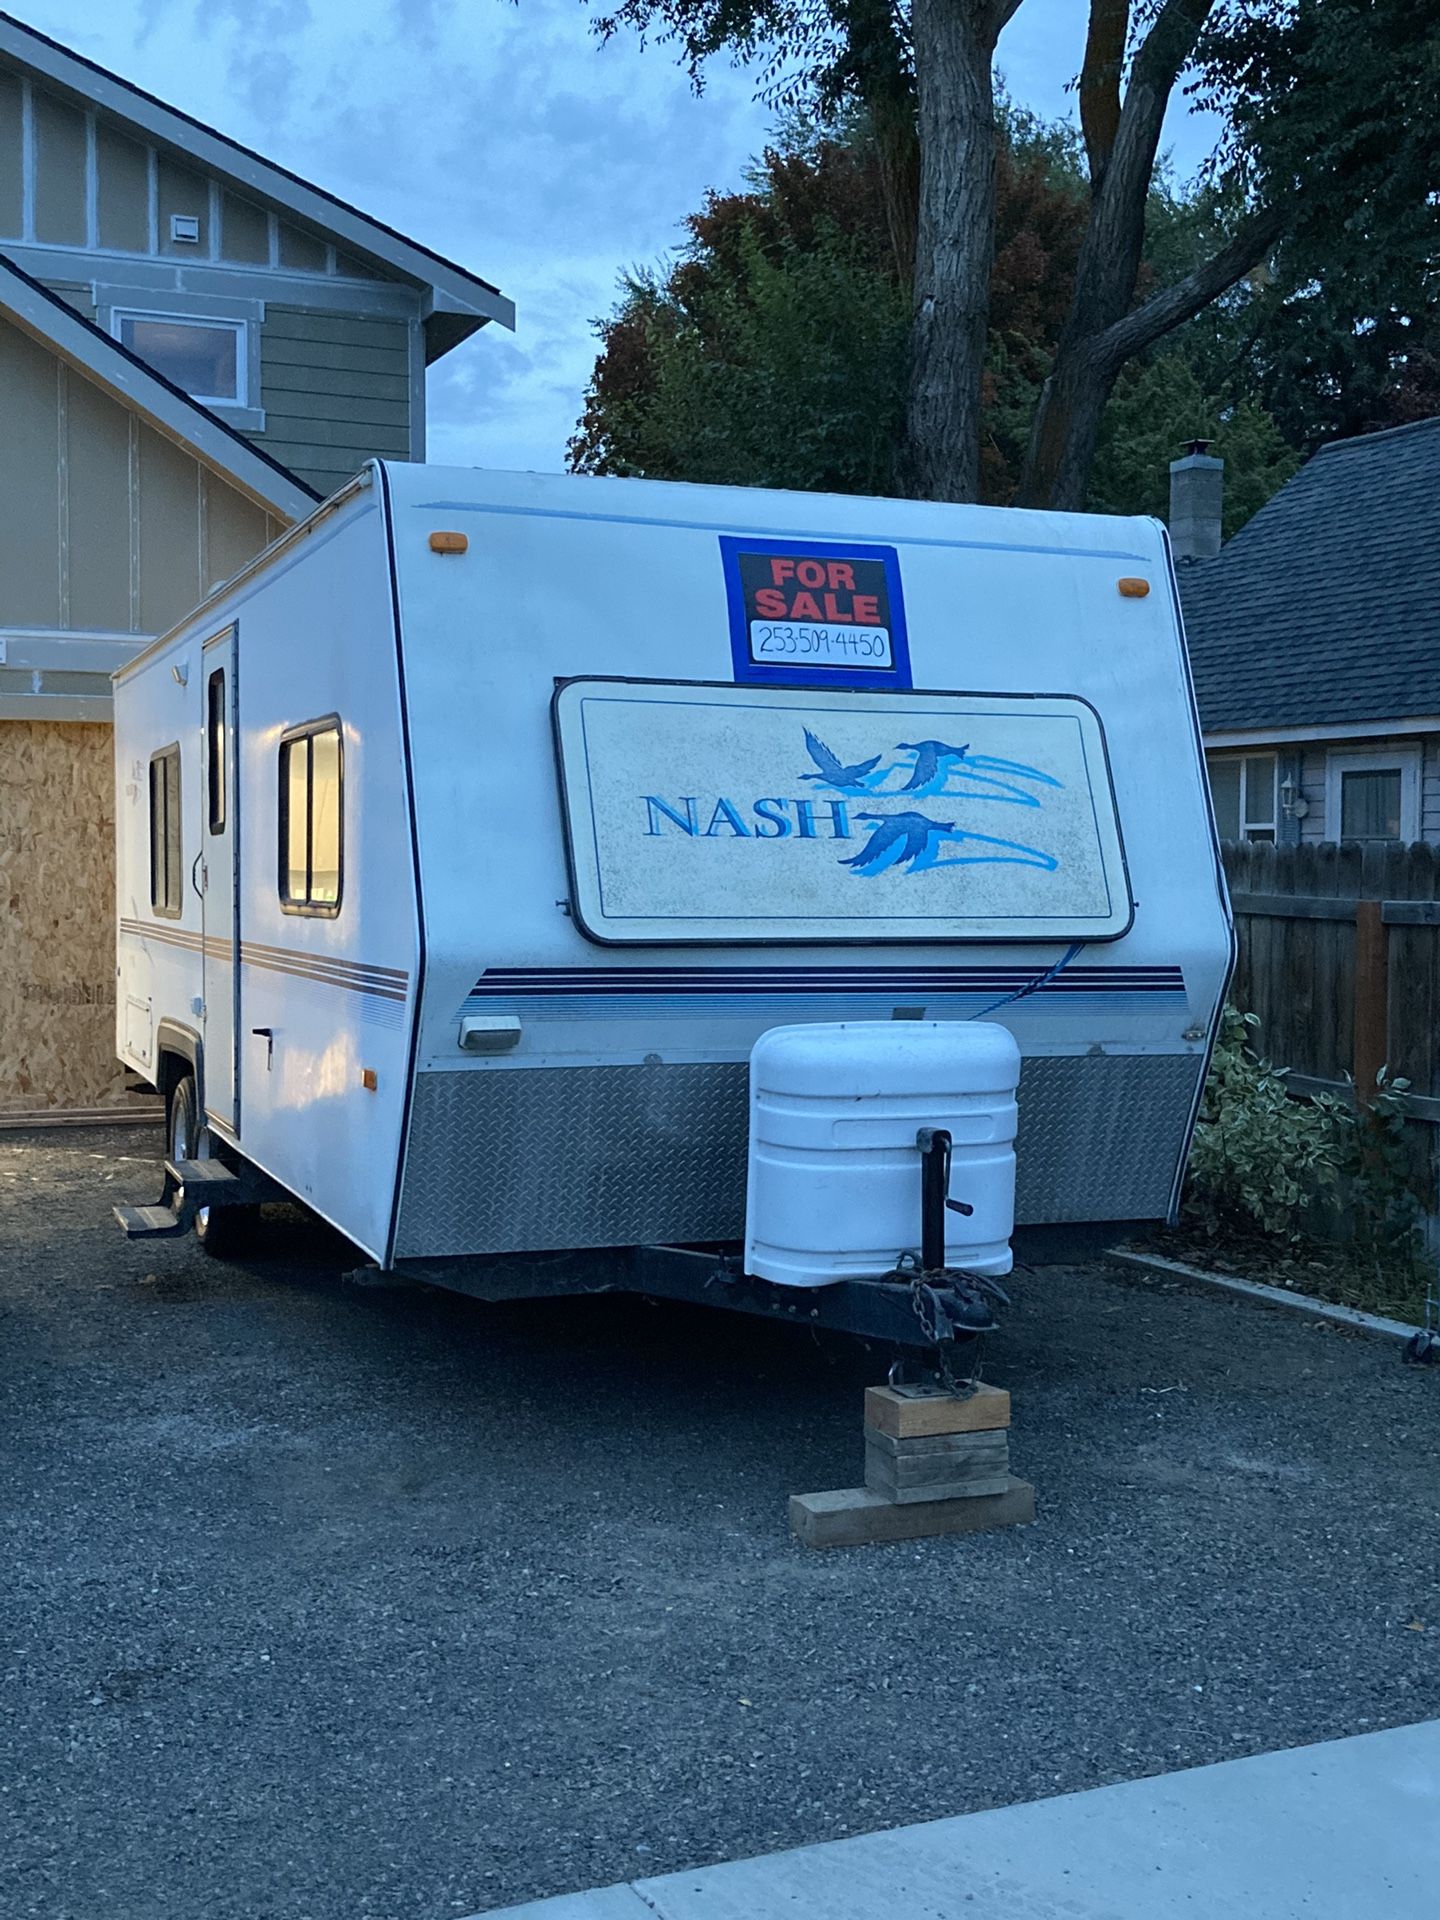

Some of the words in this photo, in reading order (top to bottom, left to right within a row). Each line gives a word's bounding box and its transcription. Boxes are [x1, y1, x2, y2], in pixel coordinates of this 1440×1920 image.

[770, 559, 856, 590] FOR
[754, 588, 881, 624] SALE
[639, 795, 852, 839] NASH
